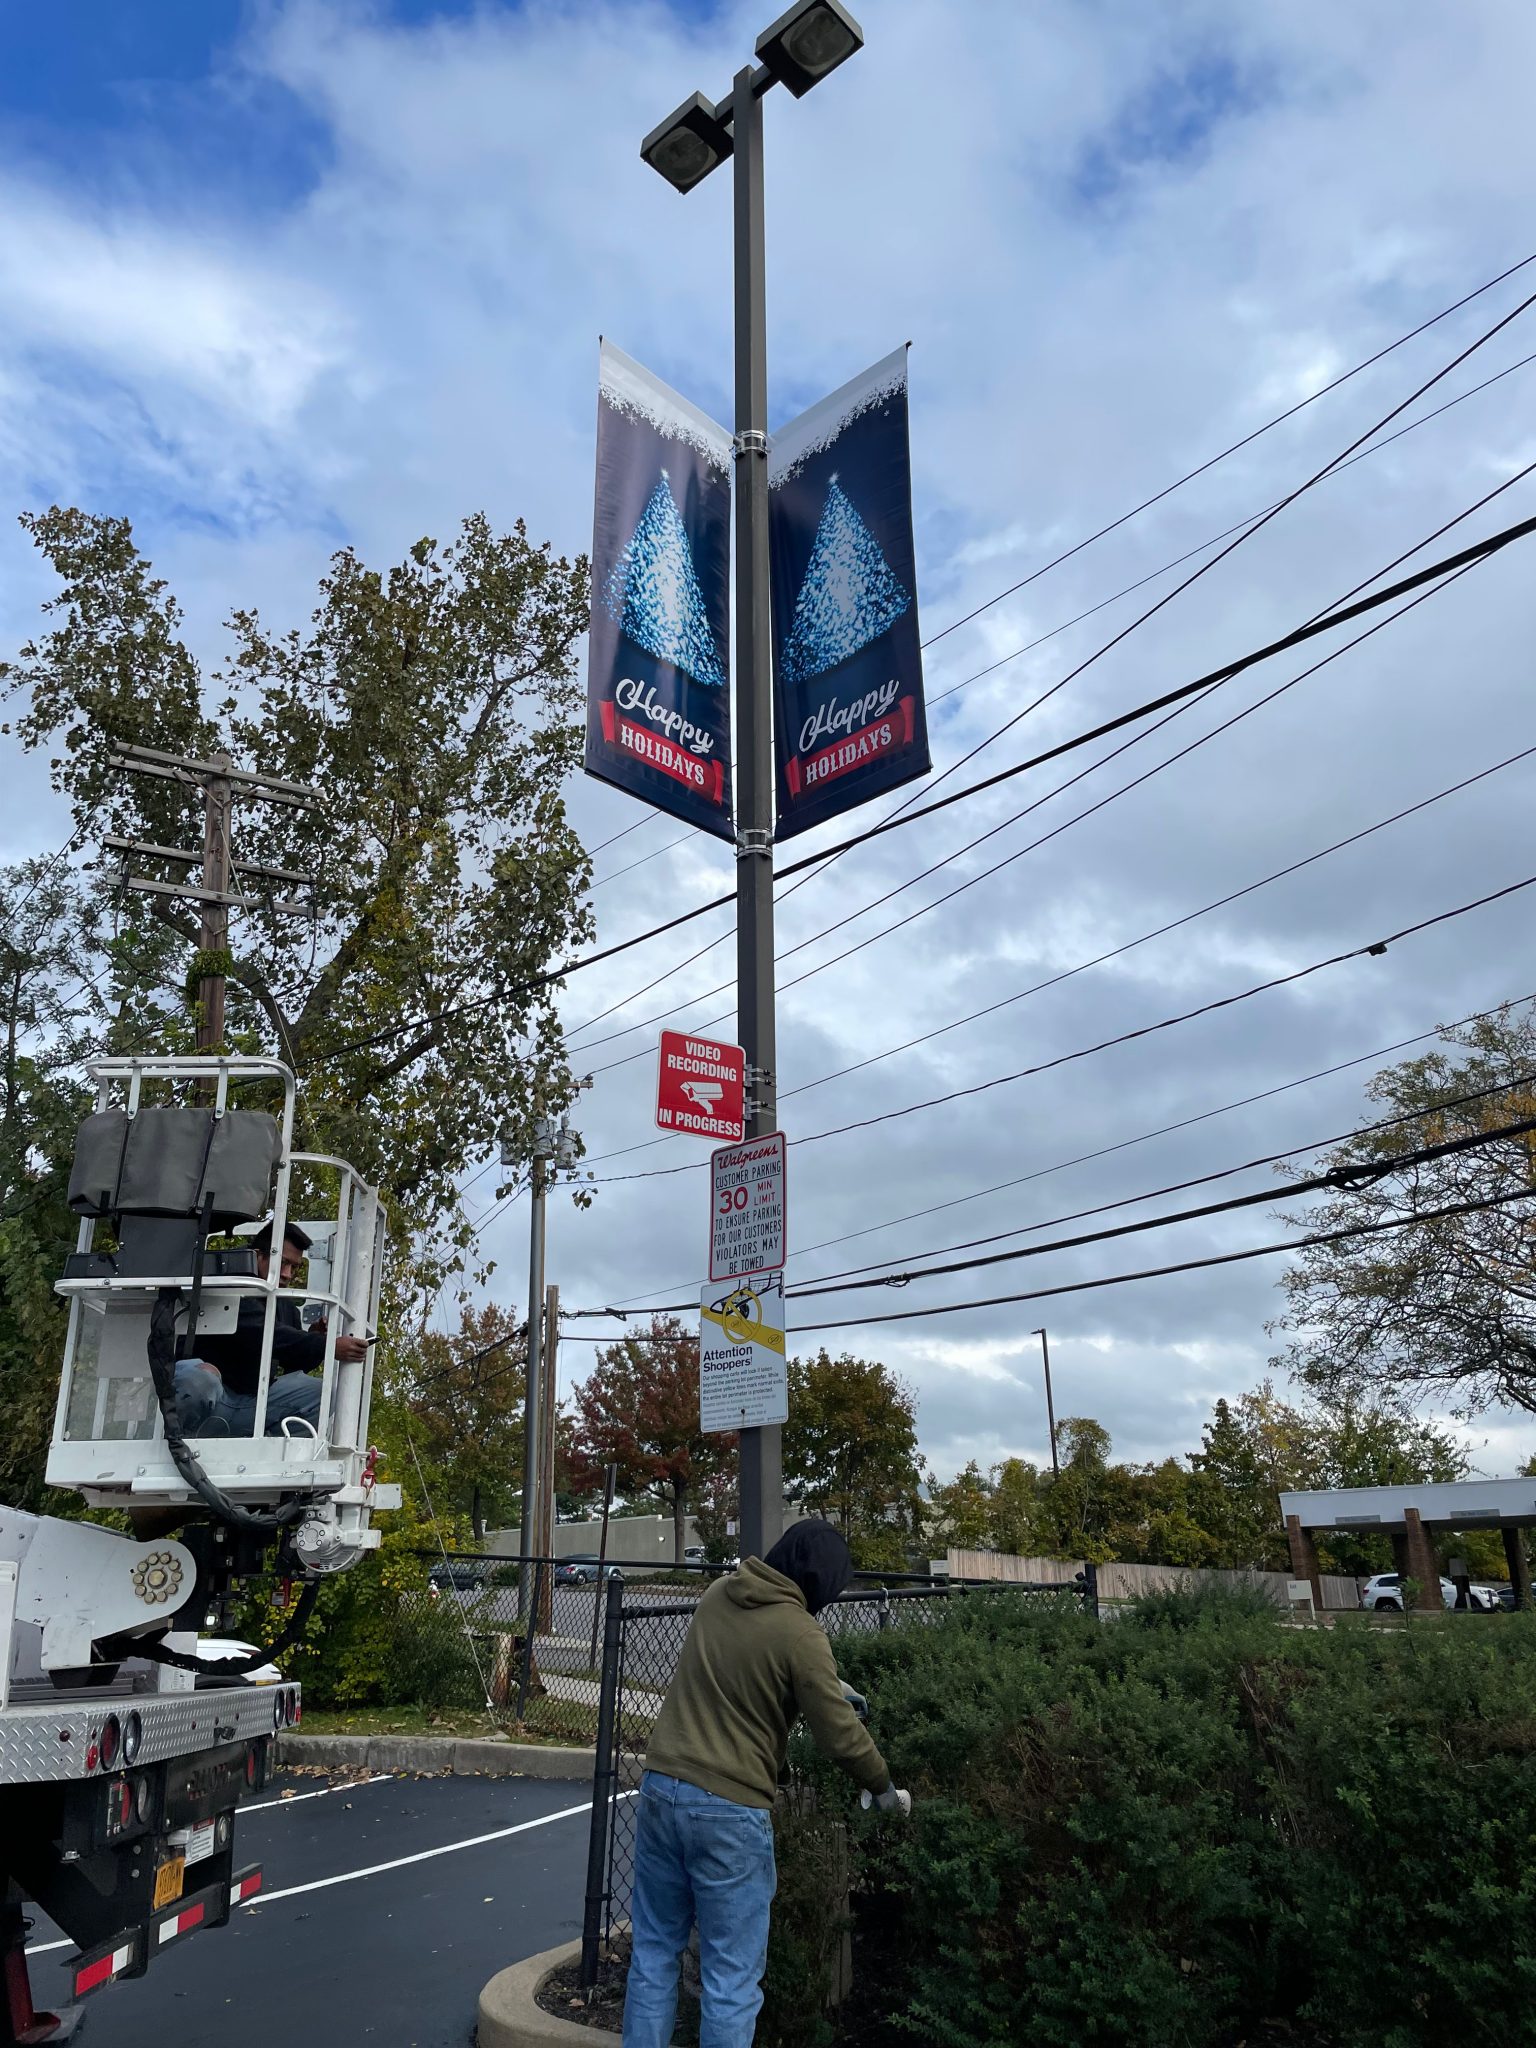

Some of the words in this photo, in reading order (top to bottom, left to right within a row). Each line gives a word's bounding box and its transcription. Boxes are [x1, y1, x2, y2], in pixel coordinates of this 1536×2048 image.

[616, 678, 714, 753] Happy
[799, 679, 899, 752] Happy
[620, 723, 705, 785] HOLIDAYS
[805, 723, 892, 785] HOLIDAYS
[685, 1041, 721, 1061] VIDEO
[667, 1054, 737, 1082] RECORDING
[659, 1108, 672, 1124] IN
[675, 1111, 741, 1137] PROGRESS
[717, 1143, 779, 1170] Walgreens
[716, 1170, 749, 1189] CUSTOMER
[752, 1160, 781, 1180] PARKING
[757, 1179, 772, 1193] MIN
[719, 1186, 749, 1215] 30
[754, 1192, 776, 1206] LIMIT
[715, 1218, 723, 1231] TO
[726, 1210, 750, 1229] ENSURE
[753, 1204, 781, 1222] PARKING
[714, 1234, 726, 1248] FOR
[729, 1230, 742, 1244] OUR
[744, 1220, 782, 1240] CUSTOMERS
[716, 1241, 758, 1262] VIOLATORS
[762, 1236, 779, 1251] MAY
[729, 1261, 738, 1275] BE
[741, 1255, 764, 1270] TOWED
[703, 1345, 753, 1362] Attention
